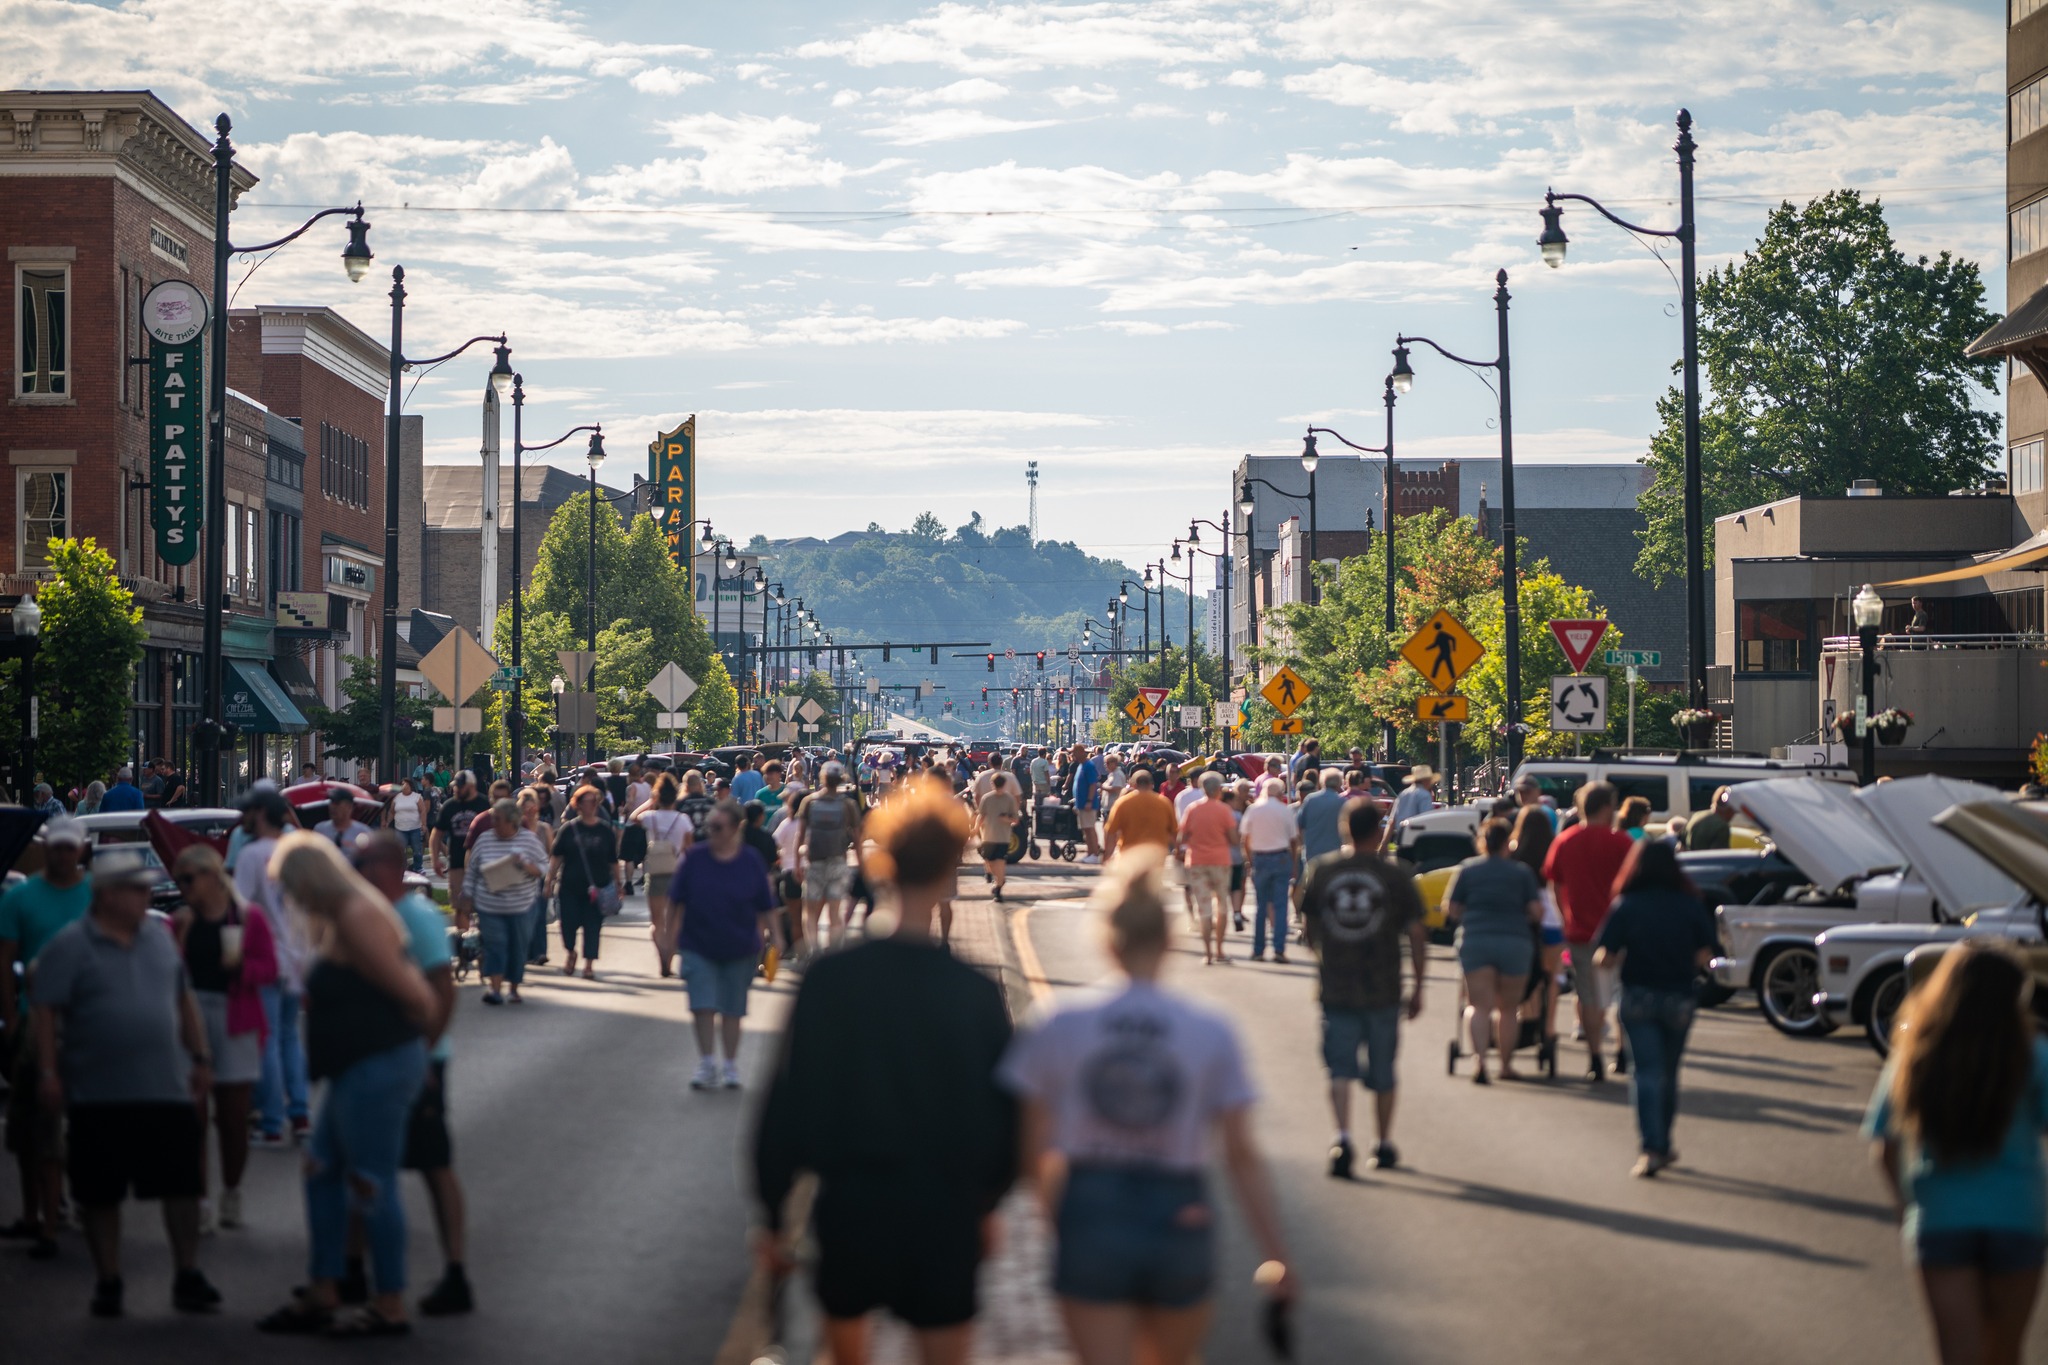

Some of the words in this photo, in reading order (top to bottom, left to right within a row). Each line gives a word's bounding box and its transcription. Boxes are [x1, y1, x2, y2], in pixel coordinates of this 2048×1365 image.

[155, 328, 173, 341] BITE
[164, 353, 186, 409] FAT
[164, 424, 186, 544] PATTY'S
[1611, 652, 1635, 664] 15th
[1641, 652, 1653, 665] St
[509, 668, 518, 677] St
